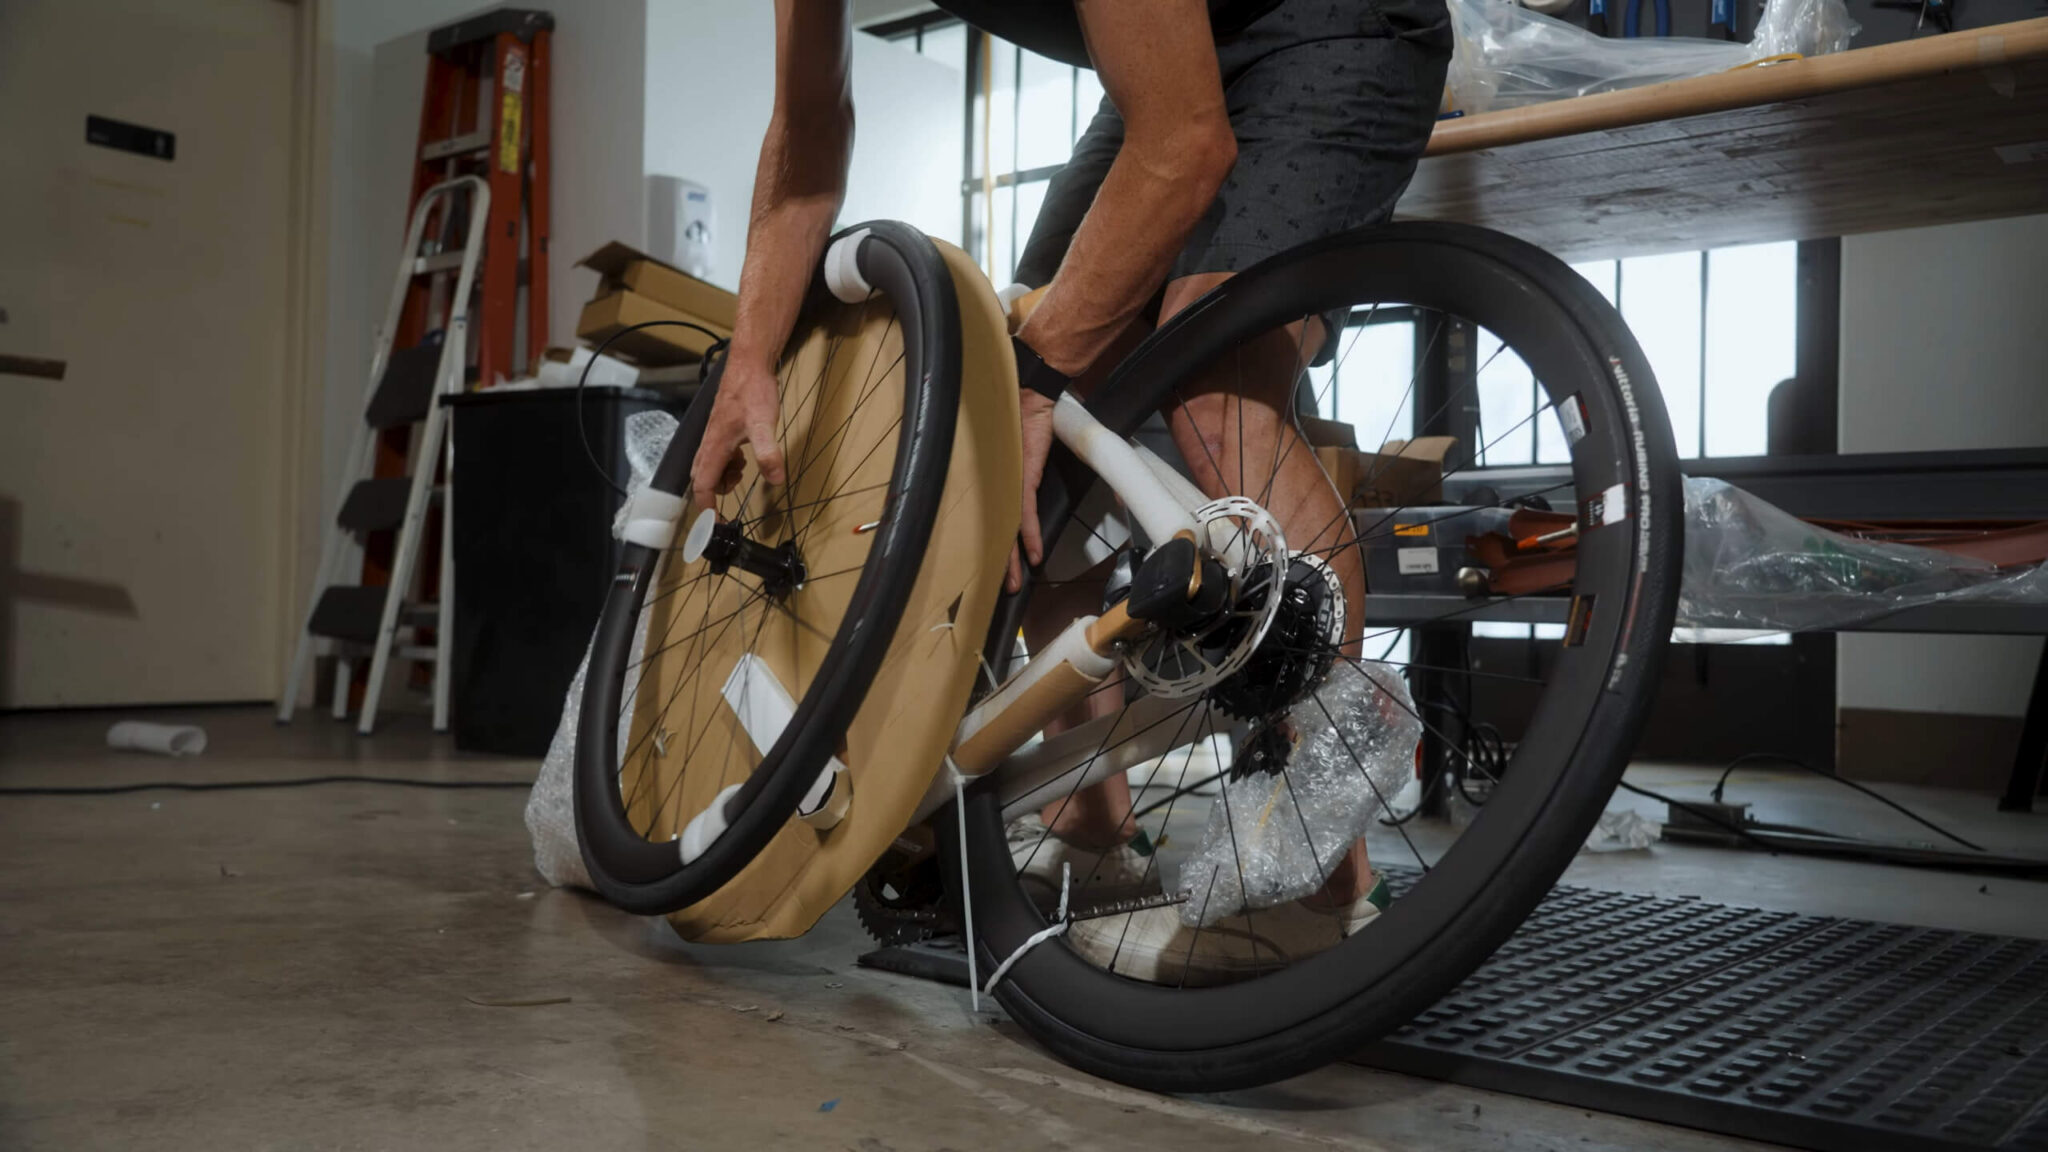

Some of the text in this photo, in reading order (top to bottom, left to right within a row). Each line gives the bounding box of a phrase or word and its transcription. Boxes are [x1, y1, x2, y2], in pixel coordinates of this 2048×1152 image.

[1613, 364, 1639, 423] vittoria
[1633, 430, 1649, 491] RUBINO
[1640, 494, 1651, 530] PRO
